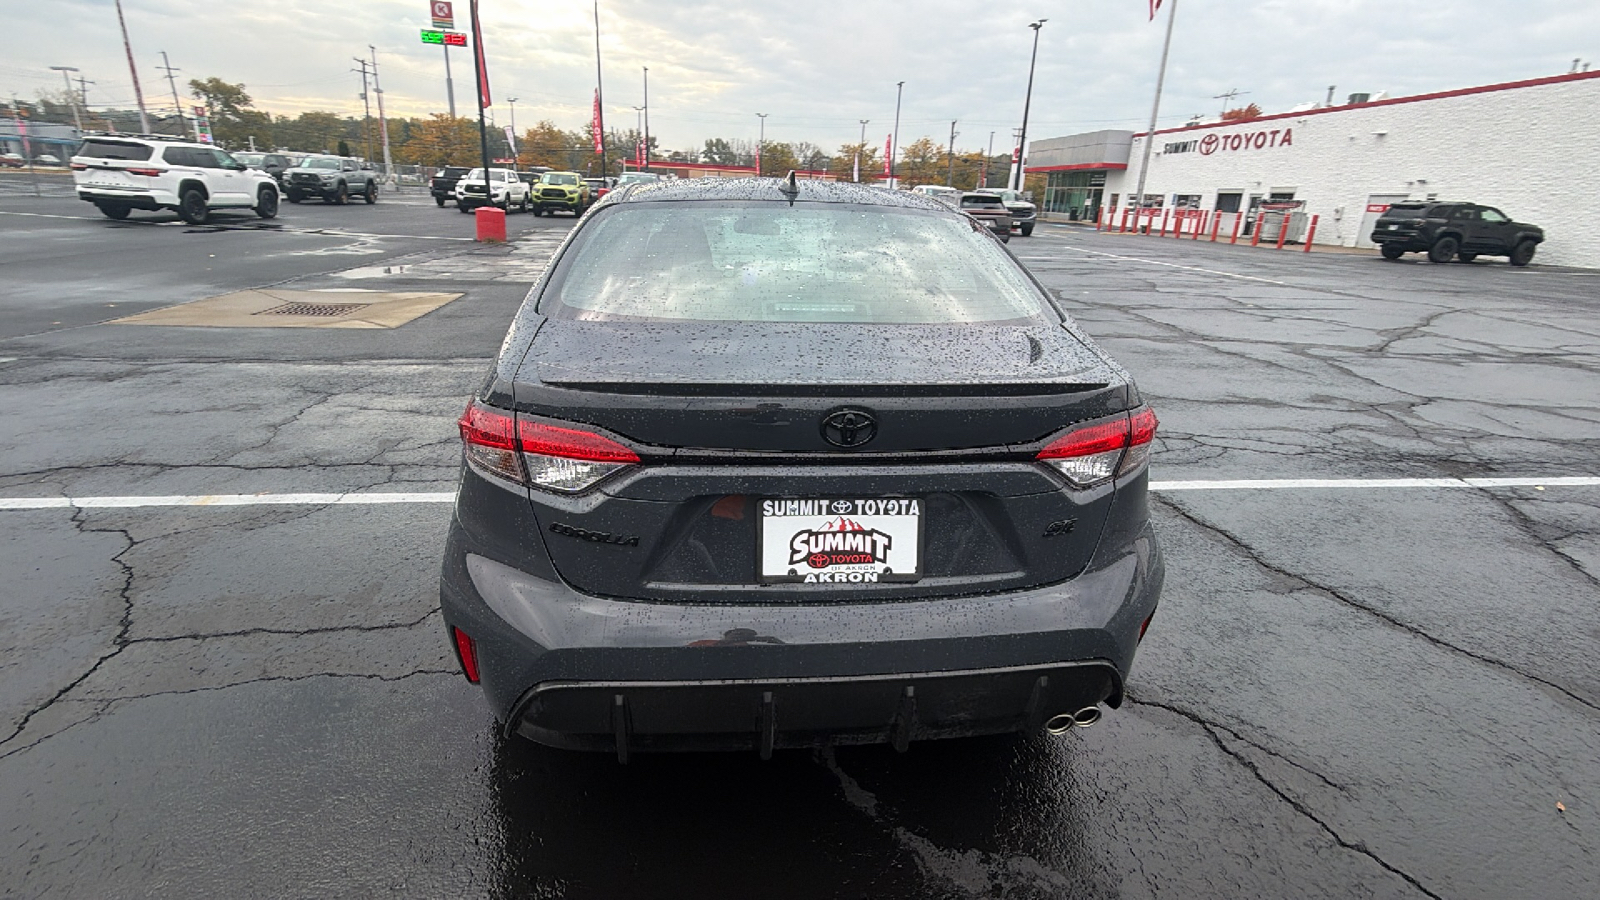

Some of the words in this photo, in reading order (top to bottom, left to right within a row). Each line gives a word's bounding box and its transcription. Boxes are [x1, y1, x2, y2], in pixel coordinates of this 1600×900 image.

[1163, 140, 1199, 154] SUMMIT
[1222, 128, 1292, 151] TOYOTA
[763, 500, 829, 516] SUMMIT
[855, 499, 920, 516] TOYOTA
[790, 529, 891, 564] SUMMIT
[831, 554, 873, 564] TOYOTA
[804, 573, 878, 583] AKRON
